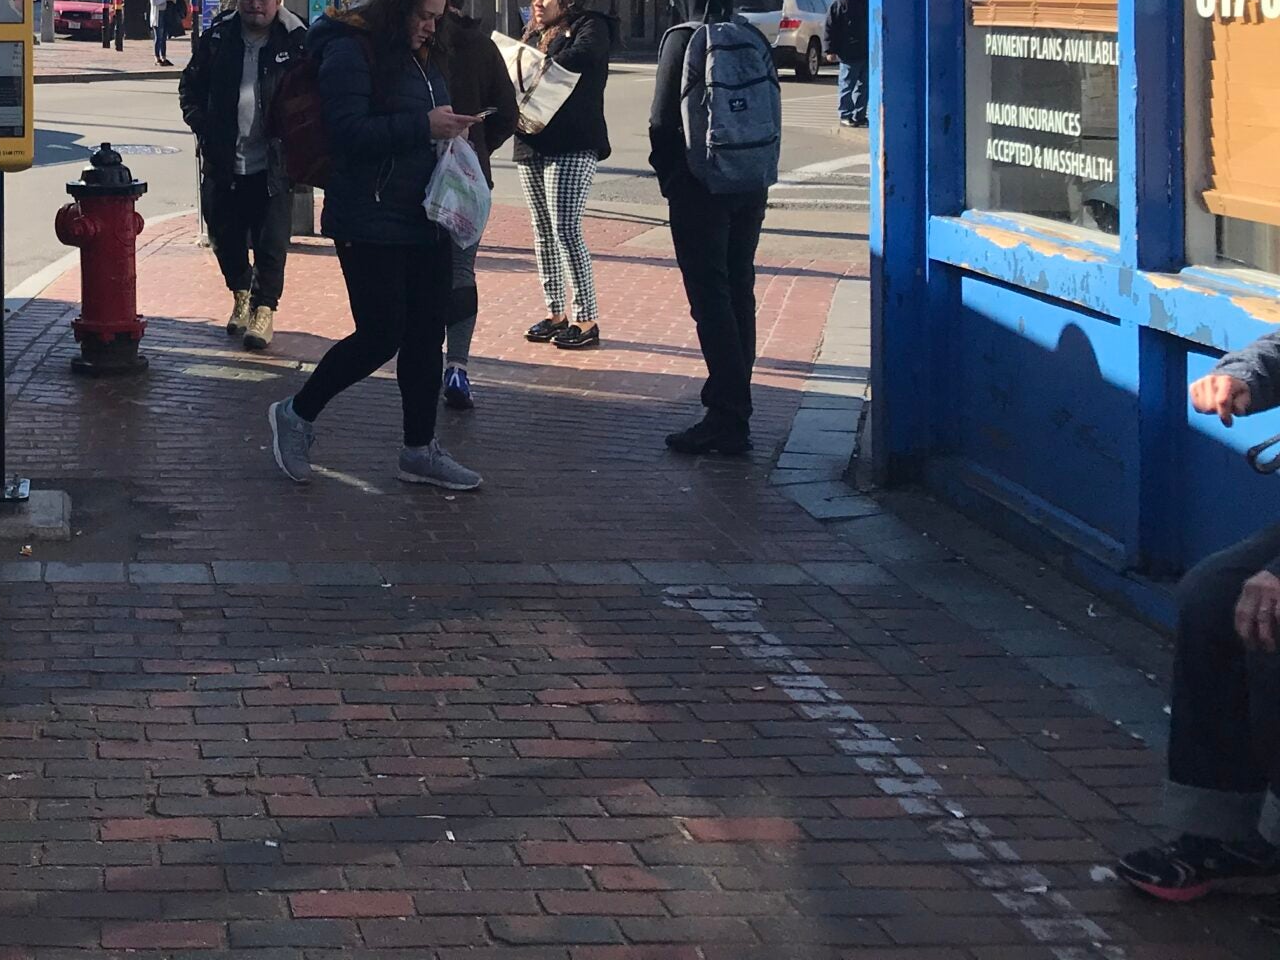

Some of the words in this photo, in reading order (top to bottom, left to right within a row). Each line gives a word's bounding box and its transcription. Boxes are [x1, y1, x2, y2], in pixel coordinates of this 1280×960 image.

[985, 33, 1030, 59] PAYMENT
[1030, 37, 1062, 62] PLANS
[985, 102, 1018, 127] MAJOR
[1018, 107, 1081, 137] INSURANCES
[985, 138, 1033, 168] ACCEPTED
[1034, 147, 1042, 169] &
[1042, 147, 1113, 183] MASSHEALTH
